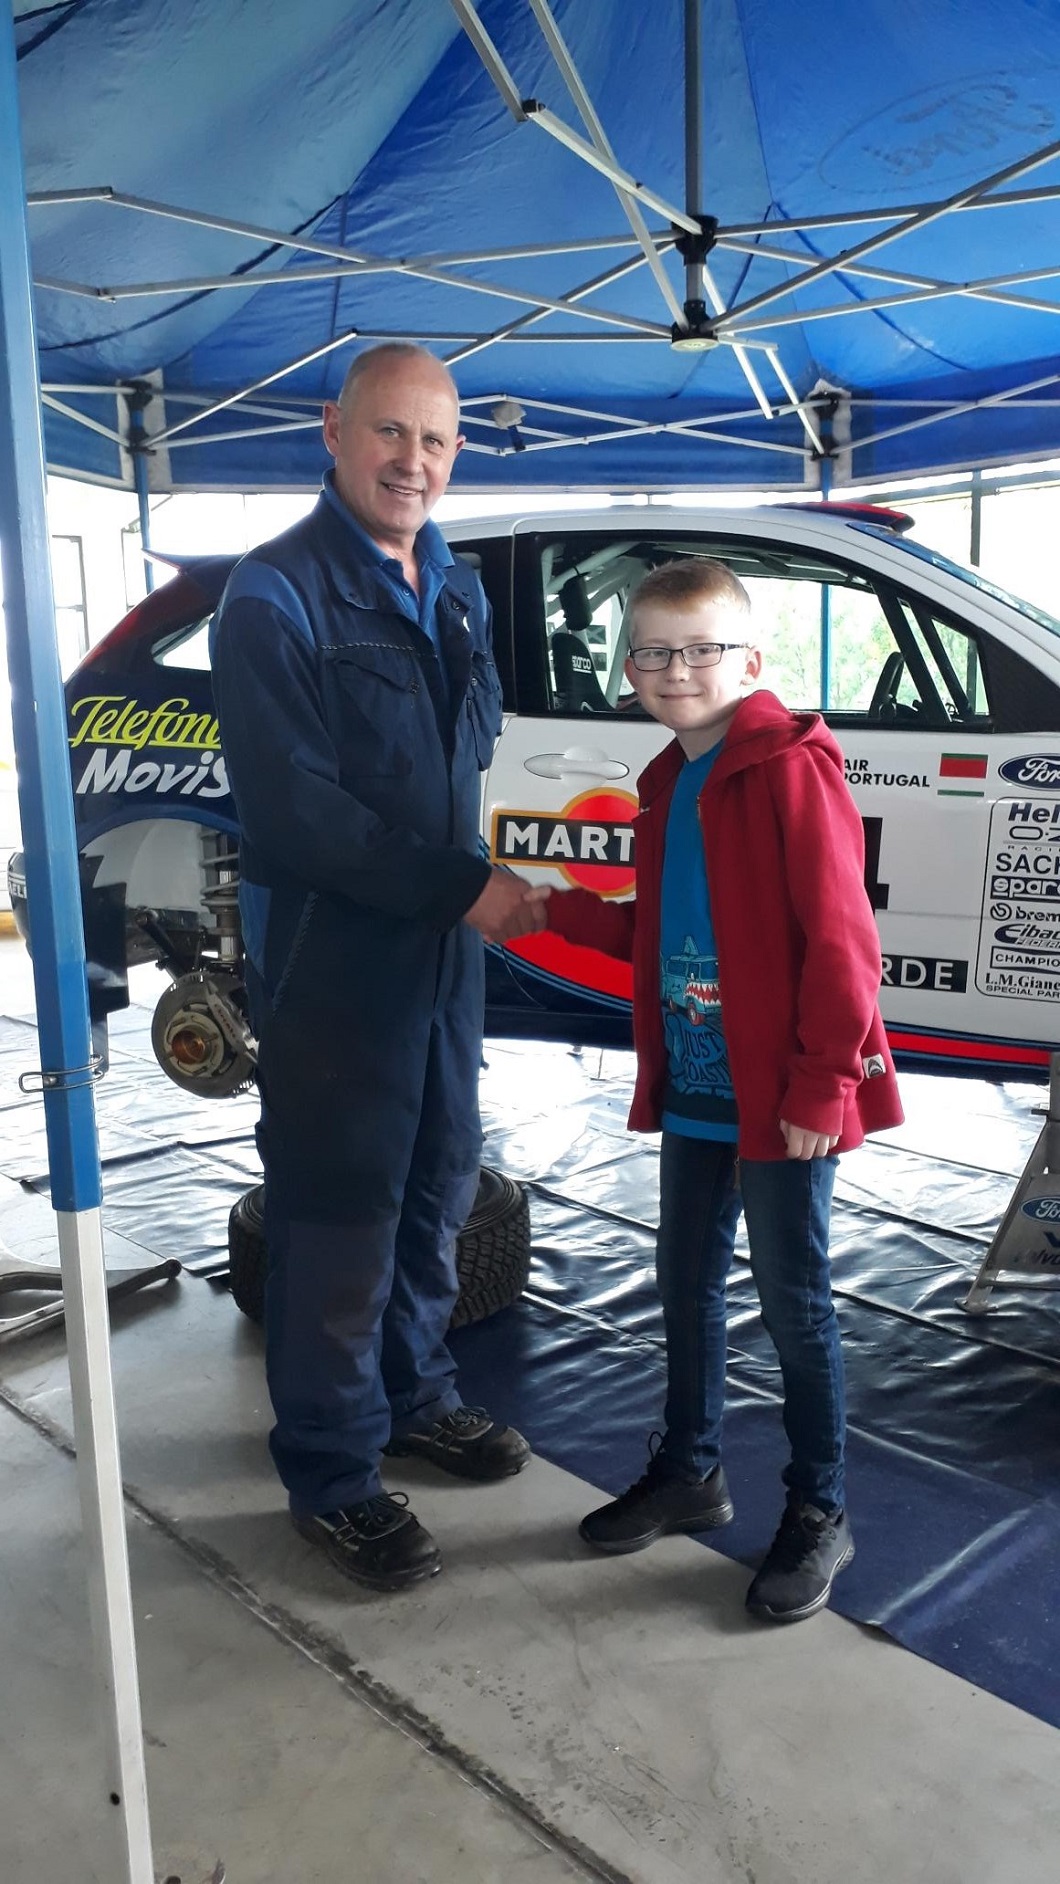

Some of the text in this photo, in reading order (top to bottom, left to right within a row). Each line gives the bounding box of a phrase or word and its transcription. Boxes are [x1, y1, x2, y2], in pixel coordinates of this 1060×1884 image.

[505, 821, 635, 862] MART
[993, 878, 1060, 898] spar
[995, 954, 1060, 967] CHAMPIO
[986, 985, 1033, 996] SPECIAL
